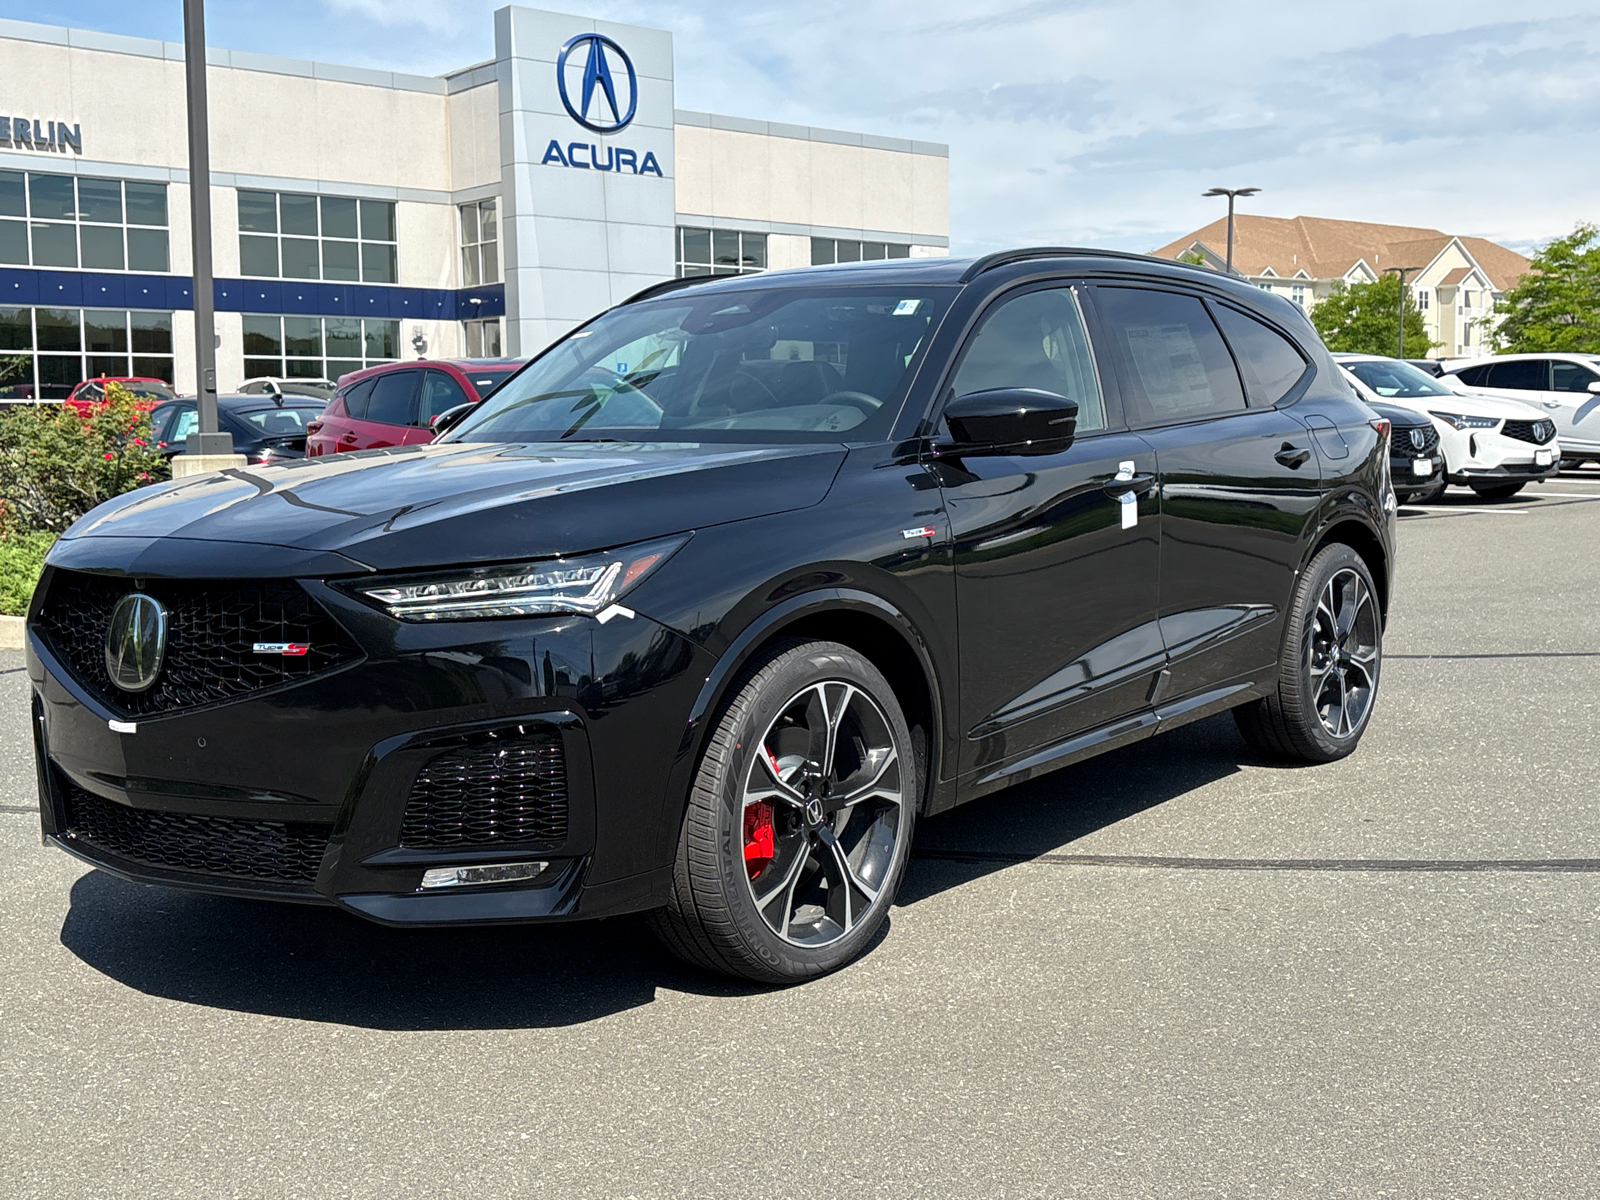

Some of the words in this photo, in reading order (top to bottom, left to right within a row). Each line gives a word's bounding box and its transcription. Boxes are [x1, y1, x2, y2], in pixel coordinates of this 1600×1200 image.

[0, 116, 82, 151] ERLIN
[541, 140, 663, 177] ACURA
[257, 644, 284, 652] Type
[722, 823, 781, 965] CONTINENTAL
